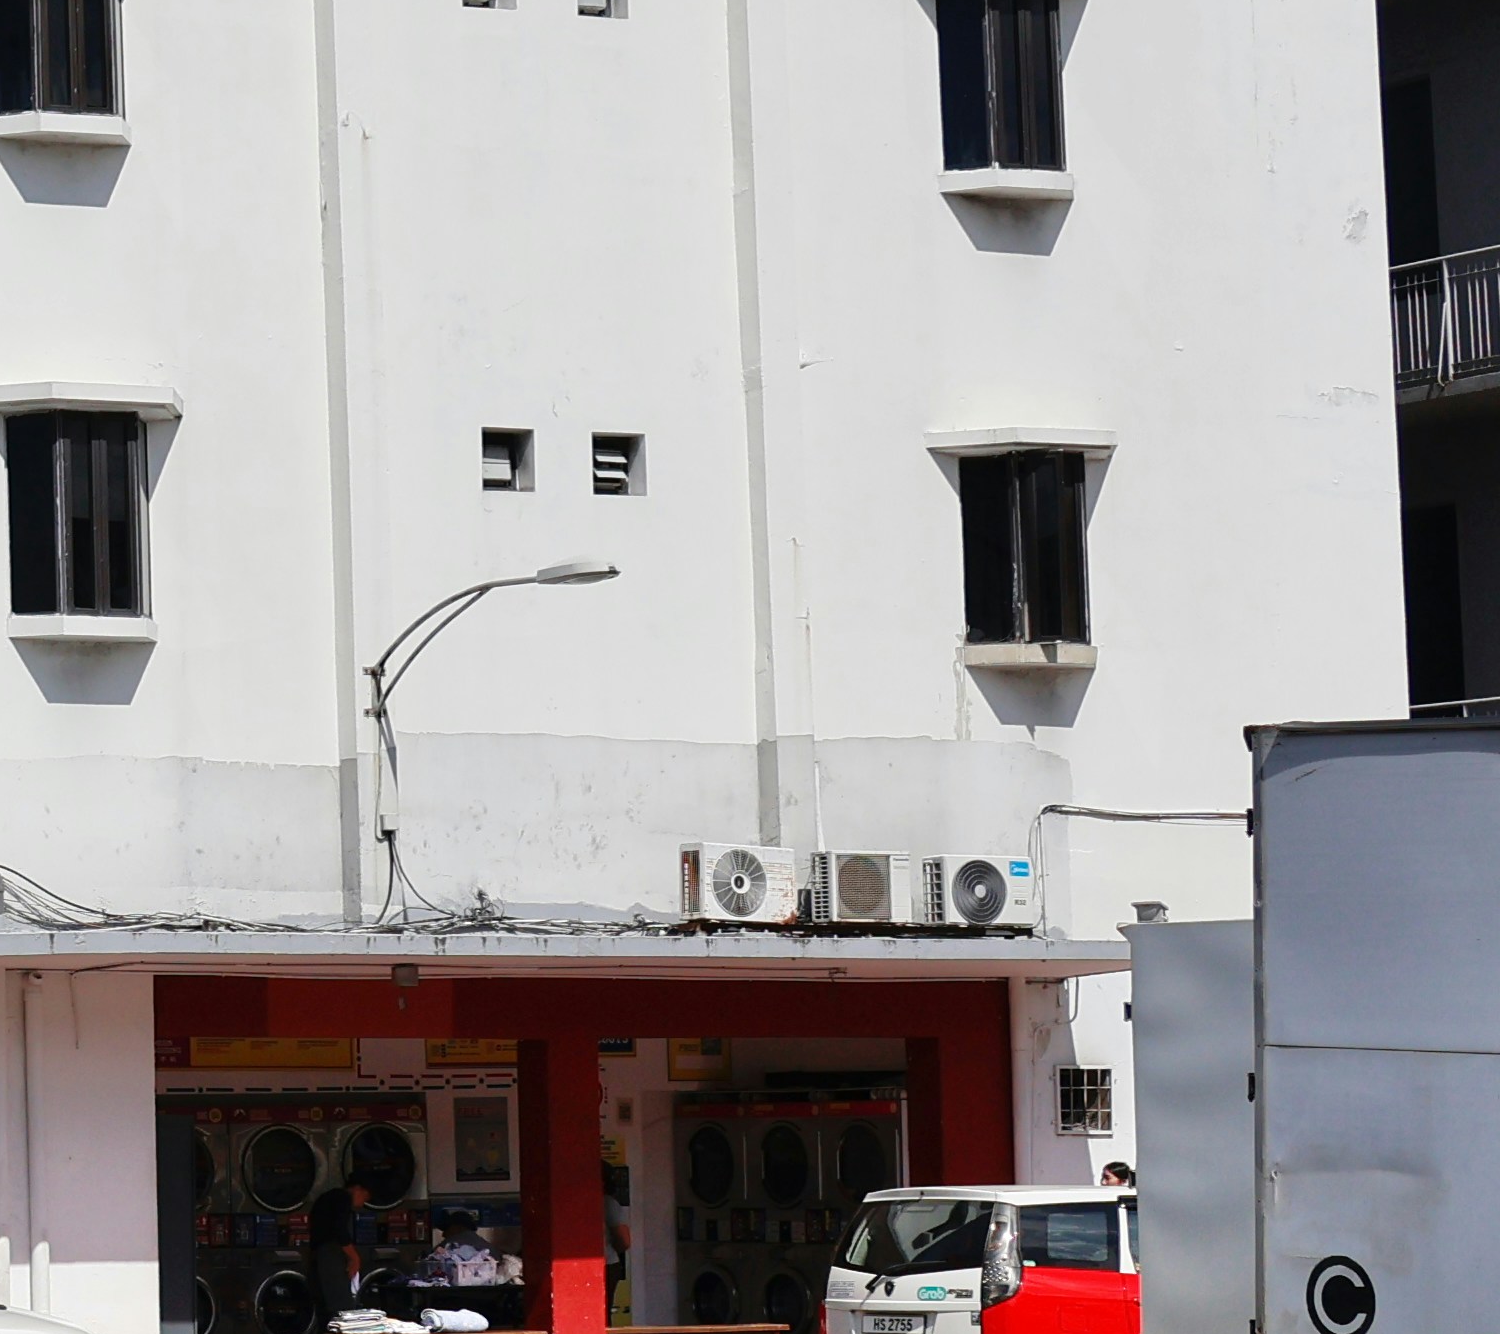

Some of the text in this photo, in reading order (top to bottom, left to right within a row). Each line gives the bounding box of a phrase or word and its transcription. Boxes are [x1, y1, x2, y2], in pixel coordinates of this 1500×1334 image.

[918, 1287, 946, 1300] Grab
[873, 1318, 913, 1332] HS 2755
